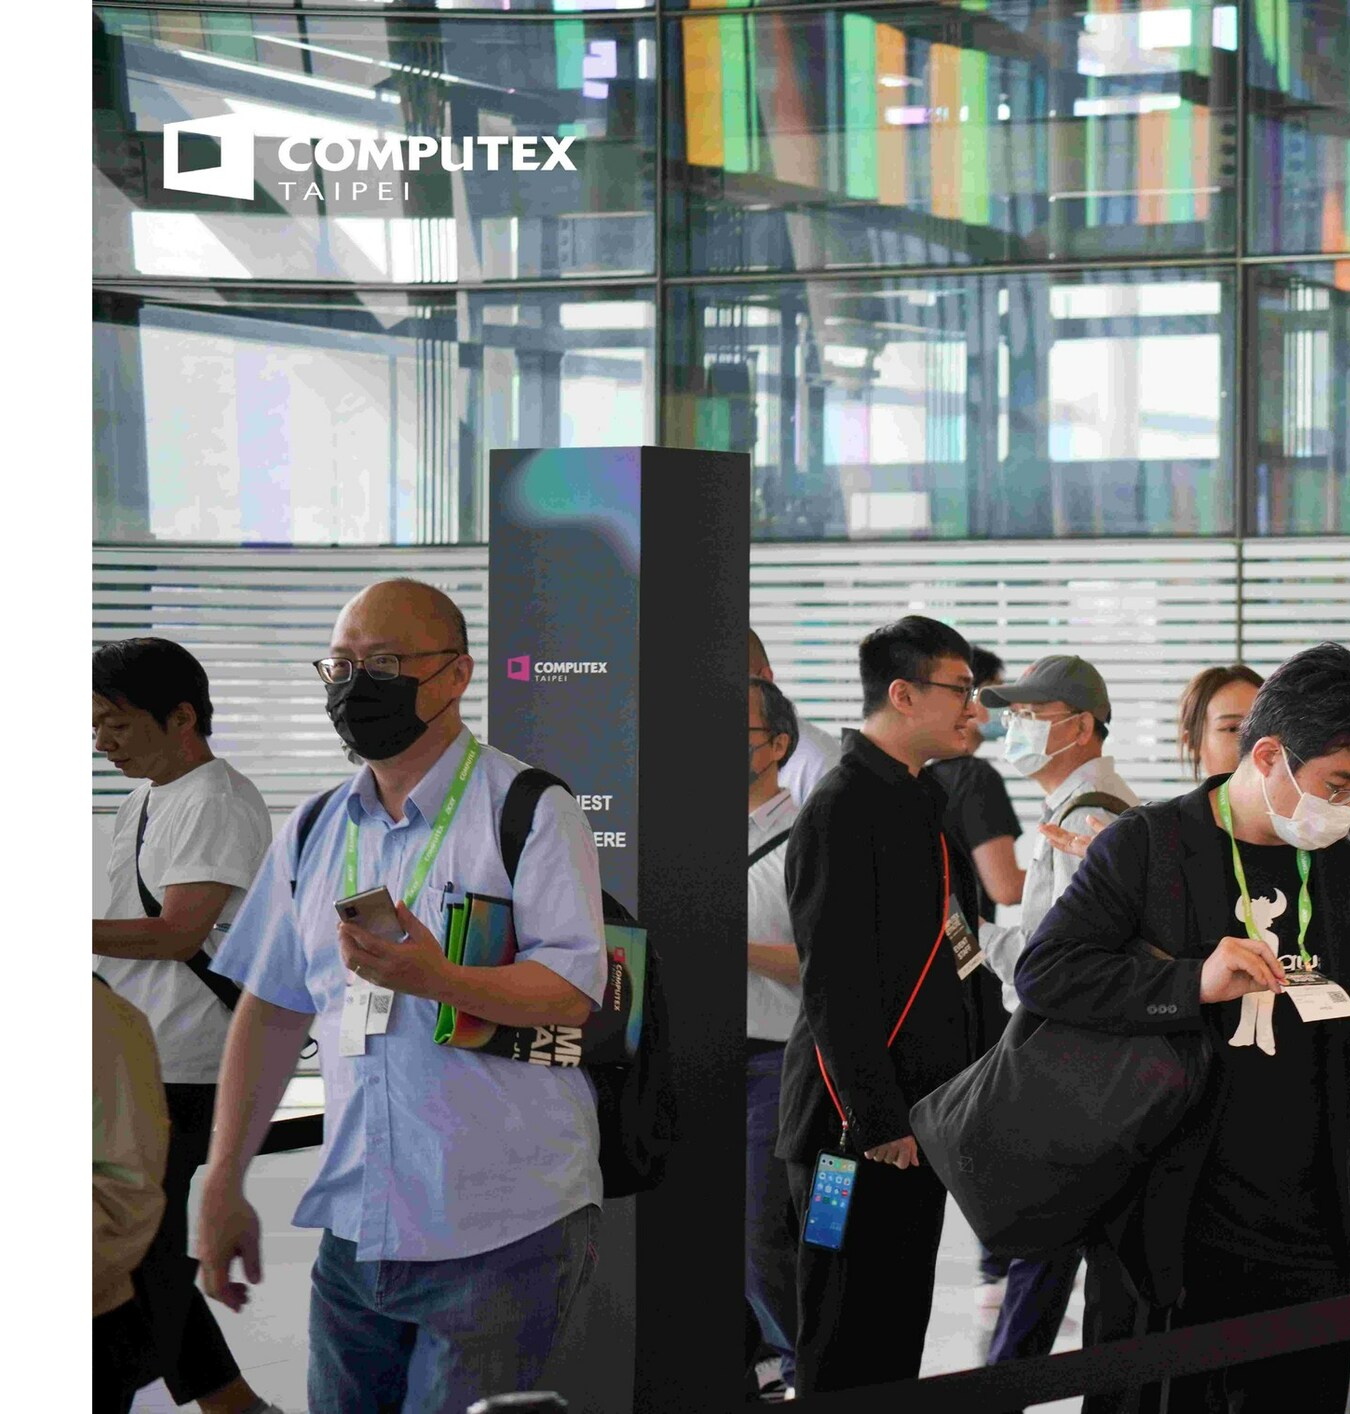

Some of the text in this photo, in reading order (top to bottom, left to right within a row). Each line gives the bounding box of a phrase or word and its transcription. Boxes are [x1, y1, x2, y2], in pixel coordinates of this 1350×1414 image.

[534, 661, 607, 674] COMPUTEX
[576, 794, 613, 811] EST
[593, 831, 627, 848] ERE
[613, 963, 623, 1012] COMPUTEX
